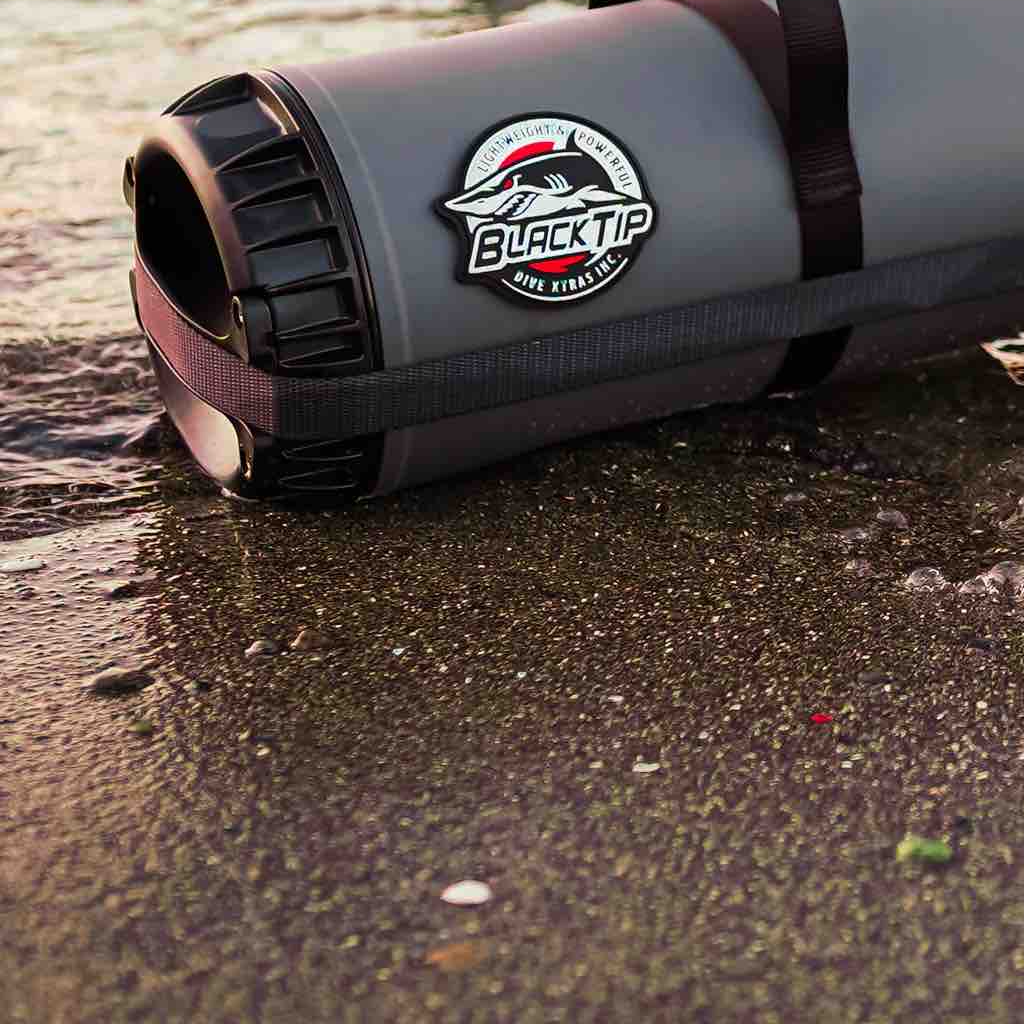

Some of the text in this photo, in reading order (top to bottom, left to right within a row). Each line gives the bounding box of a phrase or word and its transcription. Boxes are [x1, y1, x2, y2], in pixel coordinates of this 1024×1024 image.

[477, 124, 551, 174] LIGHTWEIGHT
[577, 129, 634, 189] POWERFUL
[513, 253, 622, 293] DIVE XTRAS INC.
